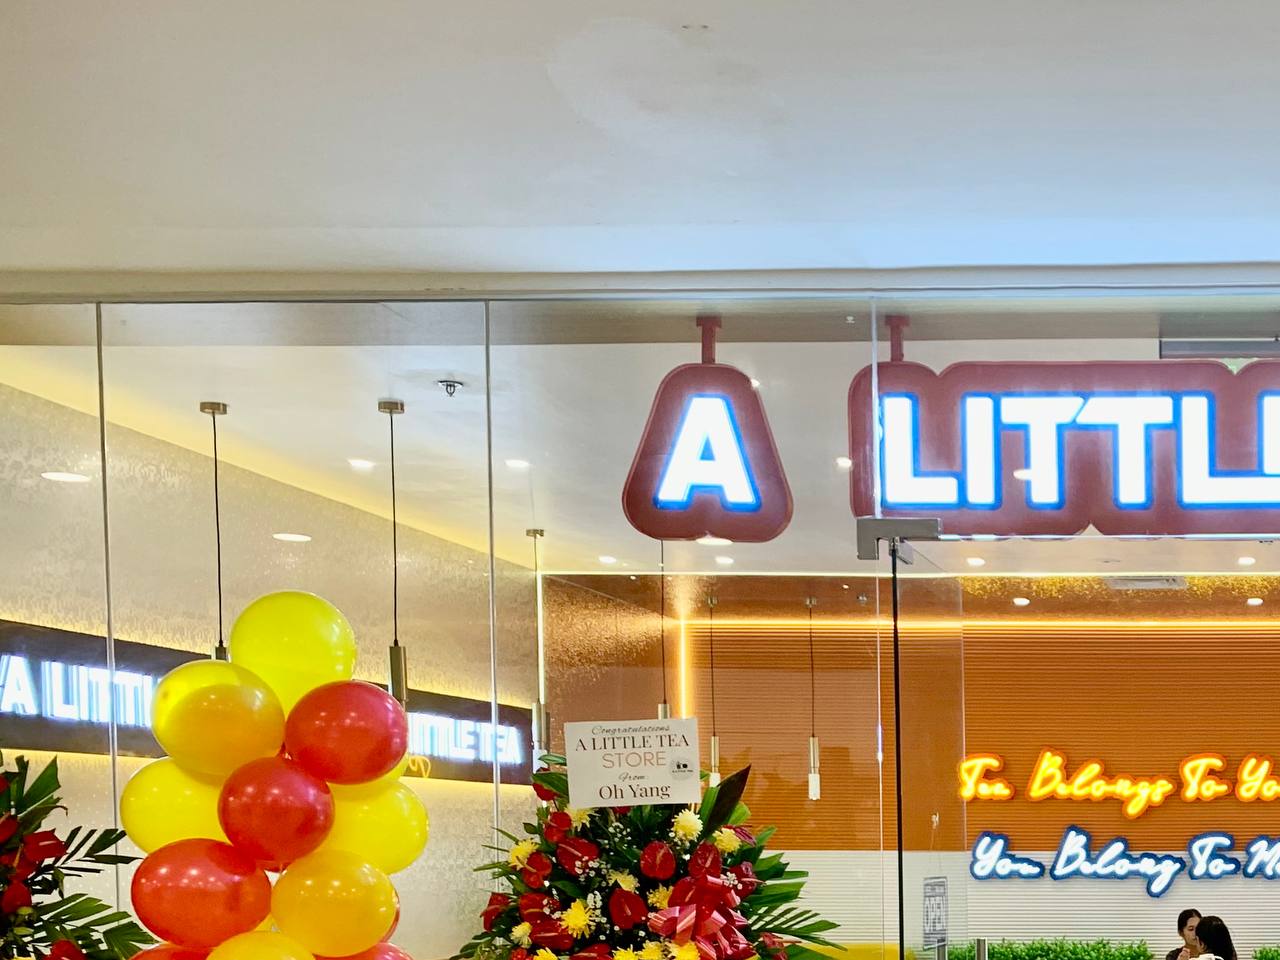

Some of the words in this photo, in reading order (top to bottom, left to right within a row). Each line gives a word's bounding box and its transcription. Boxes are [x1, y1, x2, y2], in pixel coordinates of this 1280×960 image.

[653, 392, 762, 512] A
[575, 738, 587, 751] A
[592, 735, 652, 750] LITTLE
[656, 734, 689, 747] TEA
[602, 751, 667, 769] STORE
[599, 784, 624, 800] Oh
[628, 783, 671, 800] Yang
[1029, 748, 1174, 817] Belongs
[1182, 754, 1231, 800] To
[1052, 828, 1184, 896] Belong
[1189, 834, 1240, 880] To
